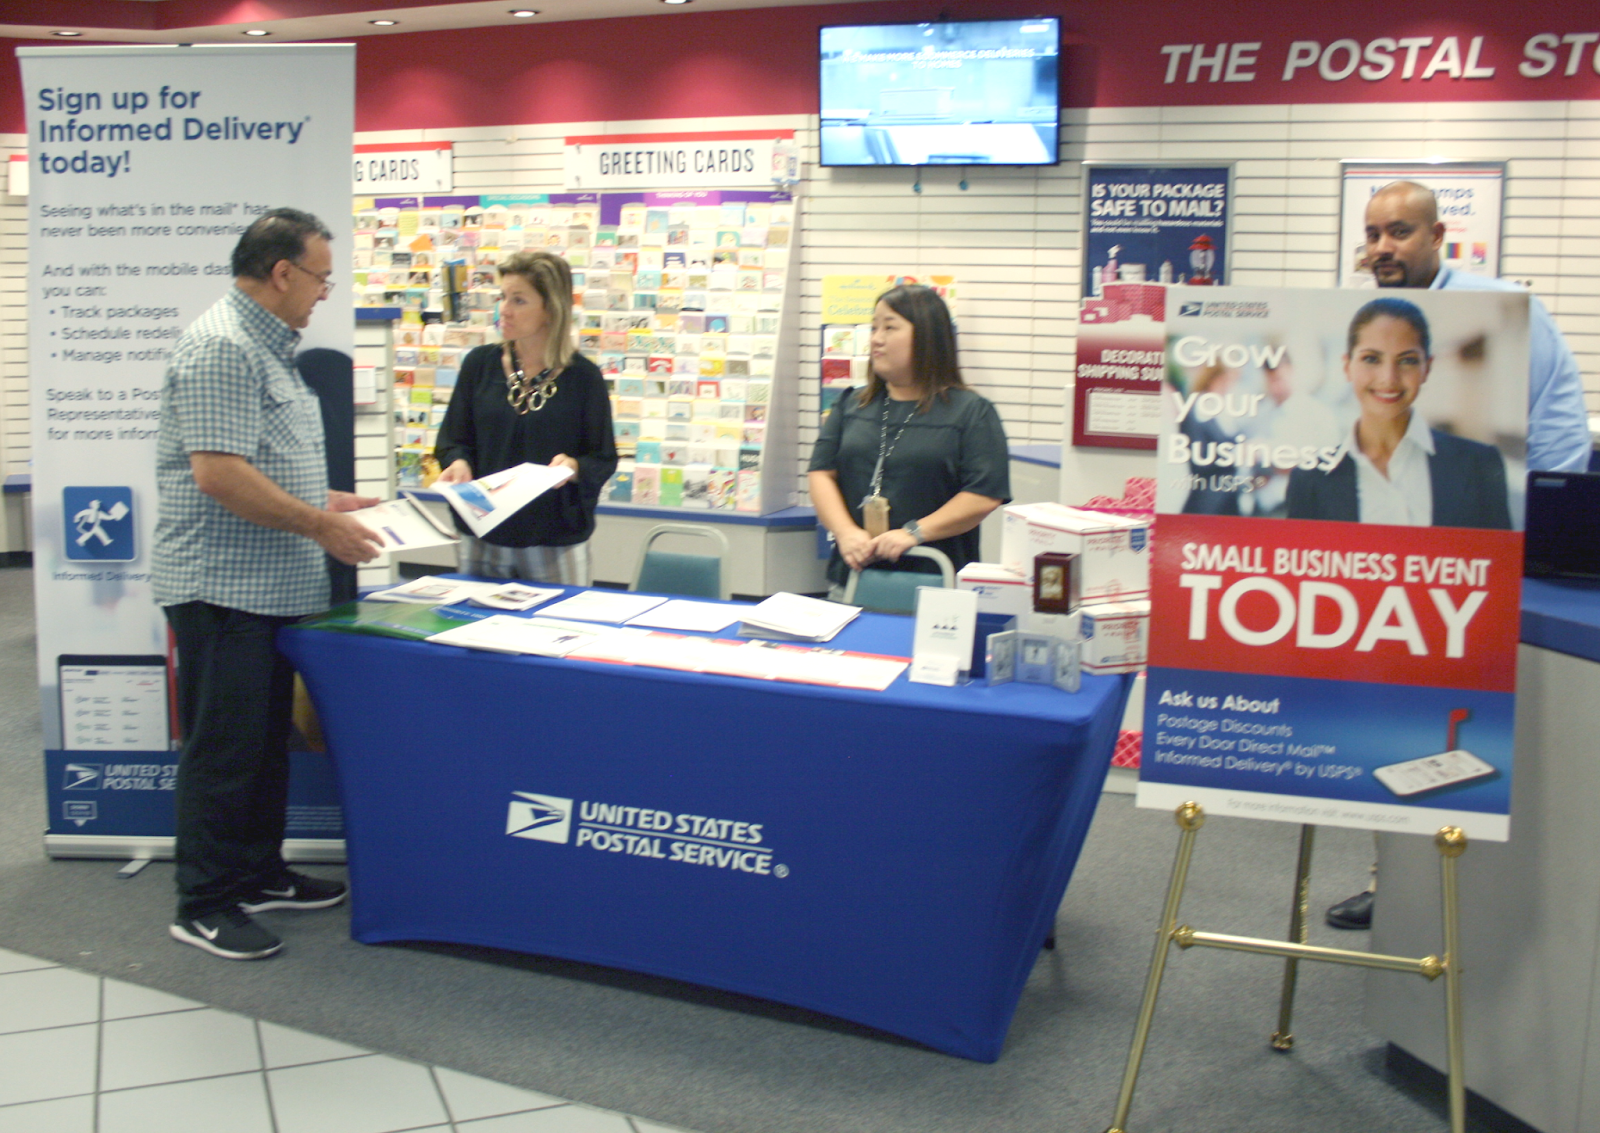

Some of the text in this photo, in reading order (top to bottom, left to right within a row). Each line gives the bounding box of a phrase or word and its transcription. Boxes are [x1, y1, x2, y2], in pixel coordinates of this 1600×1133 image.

[1160, 32, 1600, 84] THE POSTAL ST
[39, 86, 201, 114] Sign up for
[40, 117, 172, 143] Informed
[39, 151, 131, 177] today!
[354, 158, 419, 182] G CARDS
[600, 149, 686, 176] GREETING
[695, 147, 755, 174] CARDS
[1092, 183, 1225, 198] IS YOUR PACKAGE
[40, 204, 92, 220] Seeing
[97, 203, 147, 217] what's
[151, 203, 165, 216] in
[170, 202, 195, 216] the
[1091, 199, 1225, 217] SAFE TO MAIL?
[41, 222, 247, 238] never been more convenie
[42, 262, 232, 278] And with the mobile das
[41, 286, 107, 299] you can:
[60, 304, 179, 320] Track packages
[61, 326, 182, 341] Schedule redeli
[61, 349, 123, 364] Manage
[1101, 349, 1165, 365] DECORATI
[1174, 336, 1287, 368] Grow
[1077, 363, 1139, 380] SHIPPING
[46, 388, 161, 403] Speak to a Pos
[47, 406, 161, 422] Representative
[1172, 392, 1266, 423] your
[48, 427, 69, 440] for
[74, 429, 113, 441] more
[1168, 433, 1338, 471] Business
[1180, 542, 1492, 587] SMALL BUSINESS EVENT
[54, 571, 152, 583] Informed Delivery
[1179, 573, 1489, 659] TODAY
[1158, 690, 1280, 714] Ask us About
[1157, 713, 1293, 738] Postage Discounts
[1156, 731, 1197, 750] Every
[1198, 735, 1237, 751] Door
[1238, 738, 1285, 755] Direct
[104, 763, 180, 777] UNITED ST
[1154, 749, 1223, 768] Informed
[1294, 763, 1316, 779] by
[102, 777, 178, 790] POSTAL SE
[579, 800, 763, 844] UNITED STATES
[575, 828, 666, 858] POSTAL
